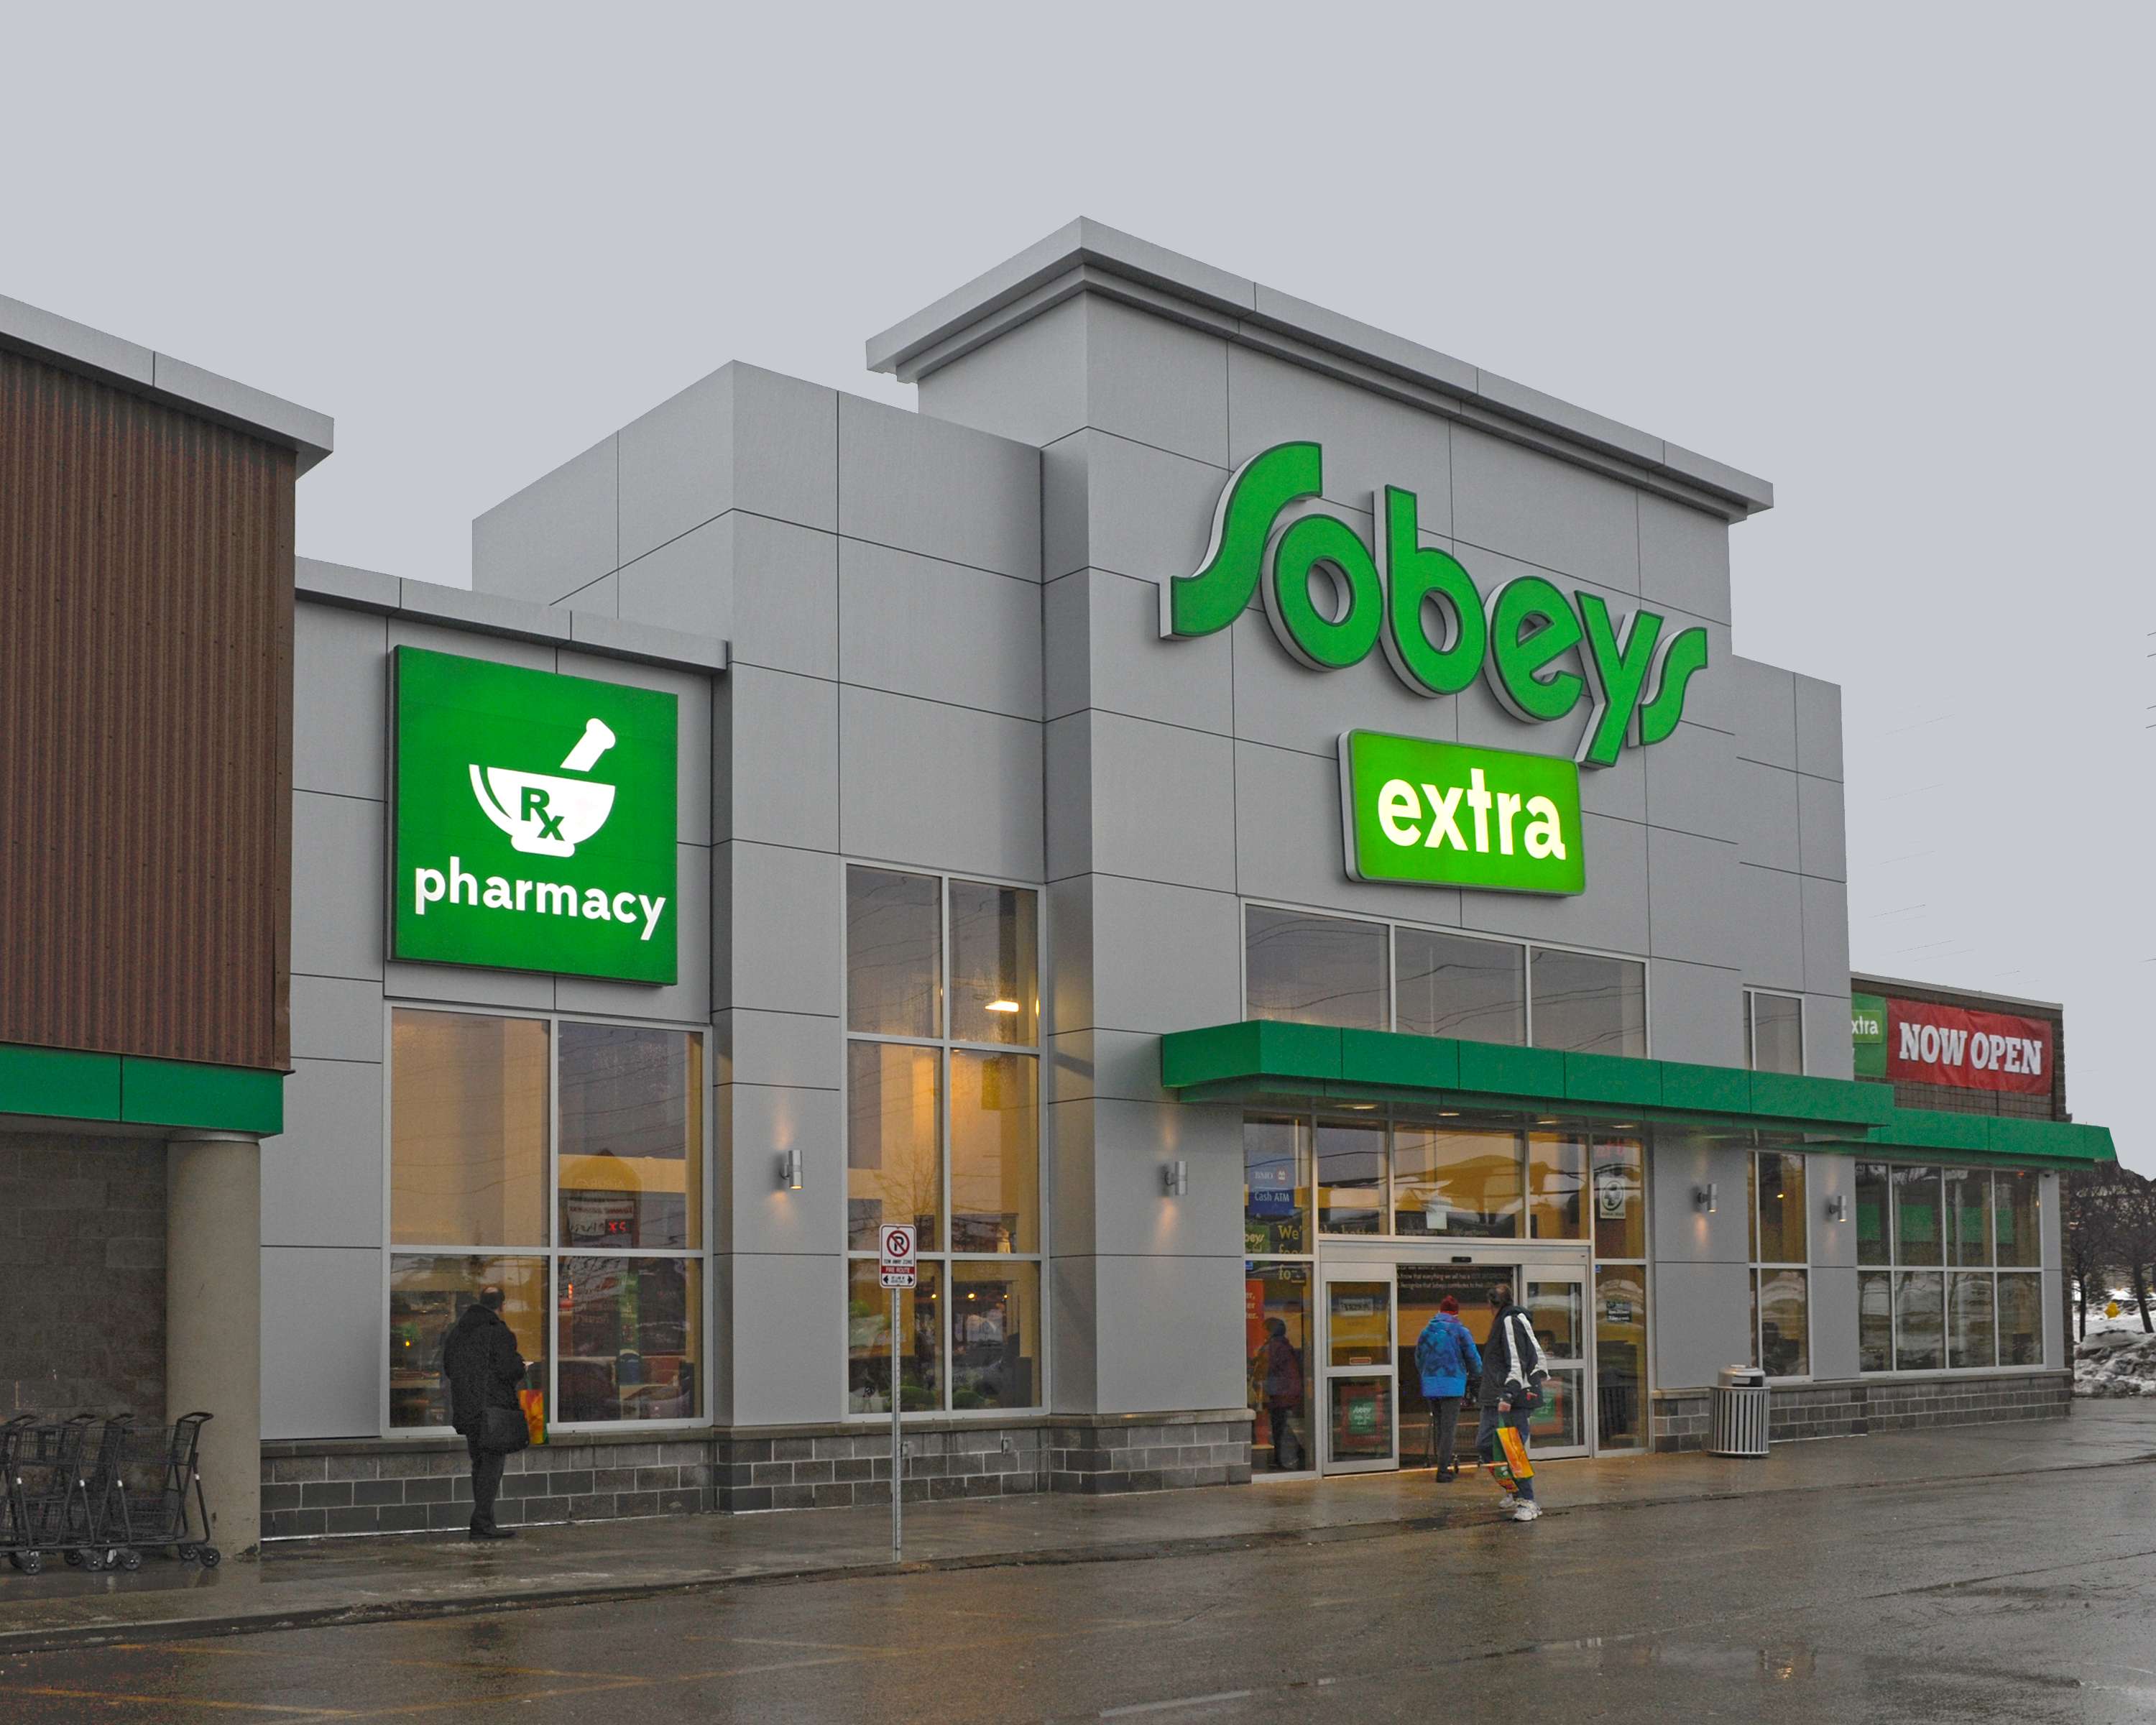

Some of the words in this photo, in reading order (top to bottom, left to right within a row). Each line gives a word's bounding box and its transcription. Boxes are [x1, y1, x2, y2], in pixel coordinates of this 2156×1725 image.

[1158, 441, 1708, 770] Sobeys
[521, 786, 565, 841] Rx
[1378, 767, 1566, 860] extra
[415, 856, 665, 941] pharmacy
[1851, 1016, 1879, 1034] xtra
[1899, 1022, 1968, 1066] NOW
[1971, 1032, 2042, 1075] OPEN
[1254, 1190, 1272, 1202] Cash
[1274, 1192, 1290, 1202] ATM
[1278, 1225, 1302, 1240] We'
